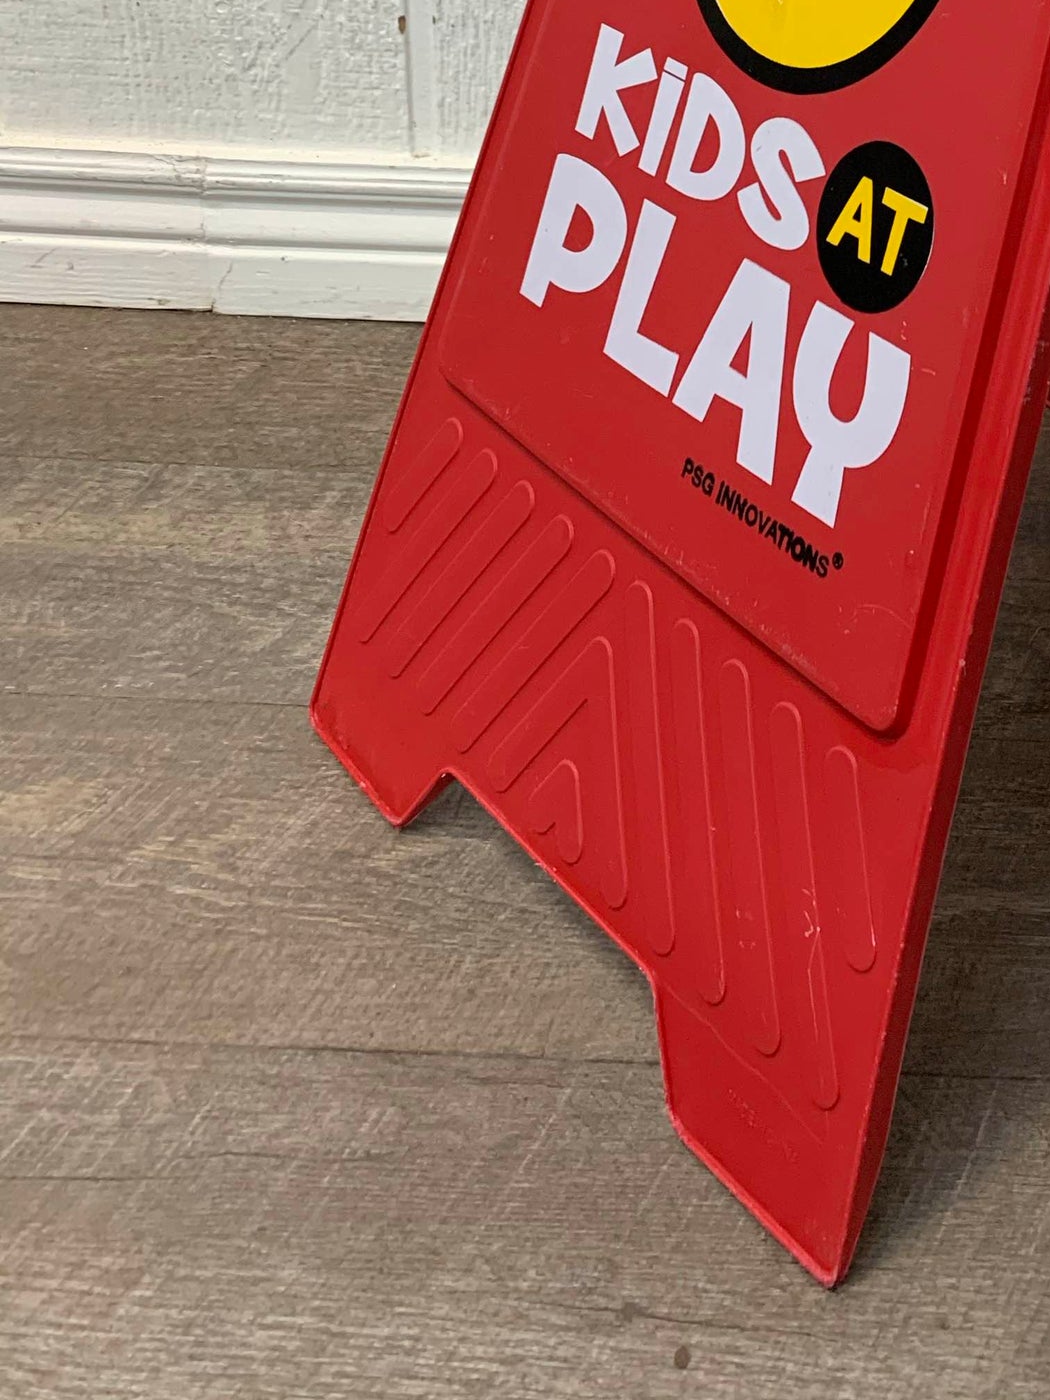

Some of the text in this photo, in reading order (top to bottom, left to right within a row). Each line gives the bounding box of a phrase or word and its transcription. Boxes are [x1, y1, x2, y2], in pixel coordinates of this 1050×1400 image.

[825, 176, 929, 276] AT
[519, 153, 911, 529] PLAY
[680, 457, 716, 497] PSG
